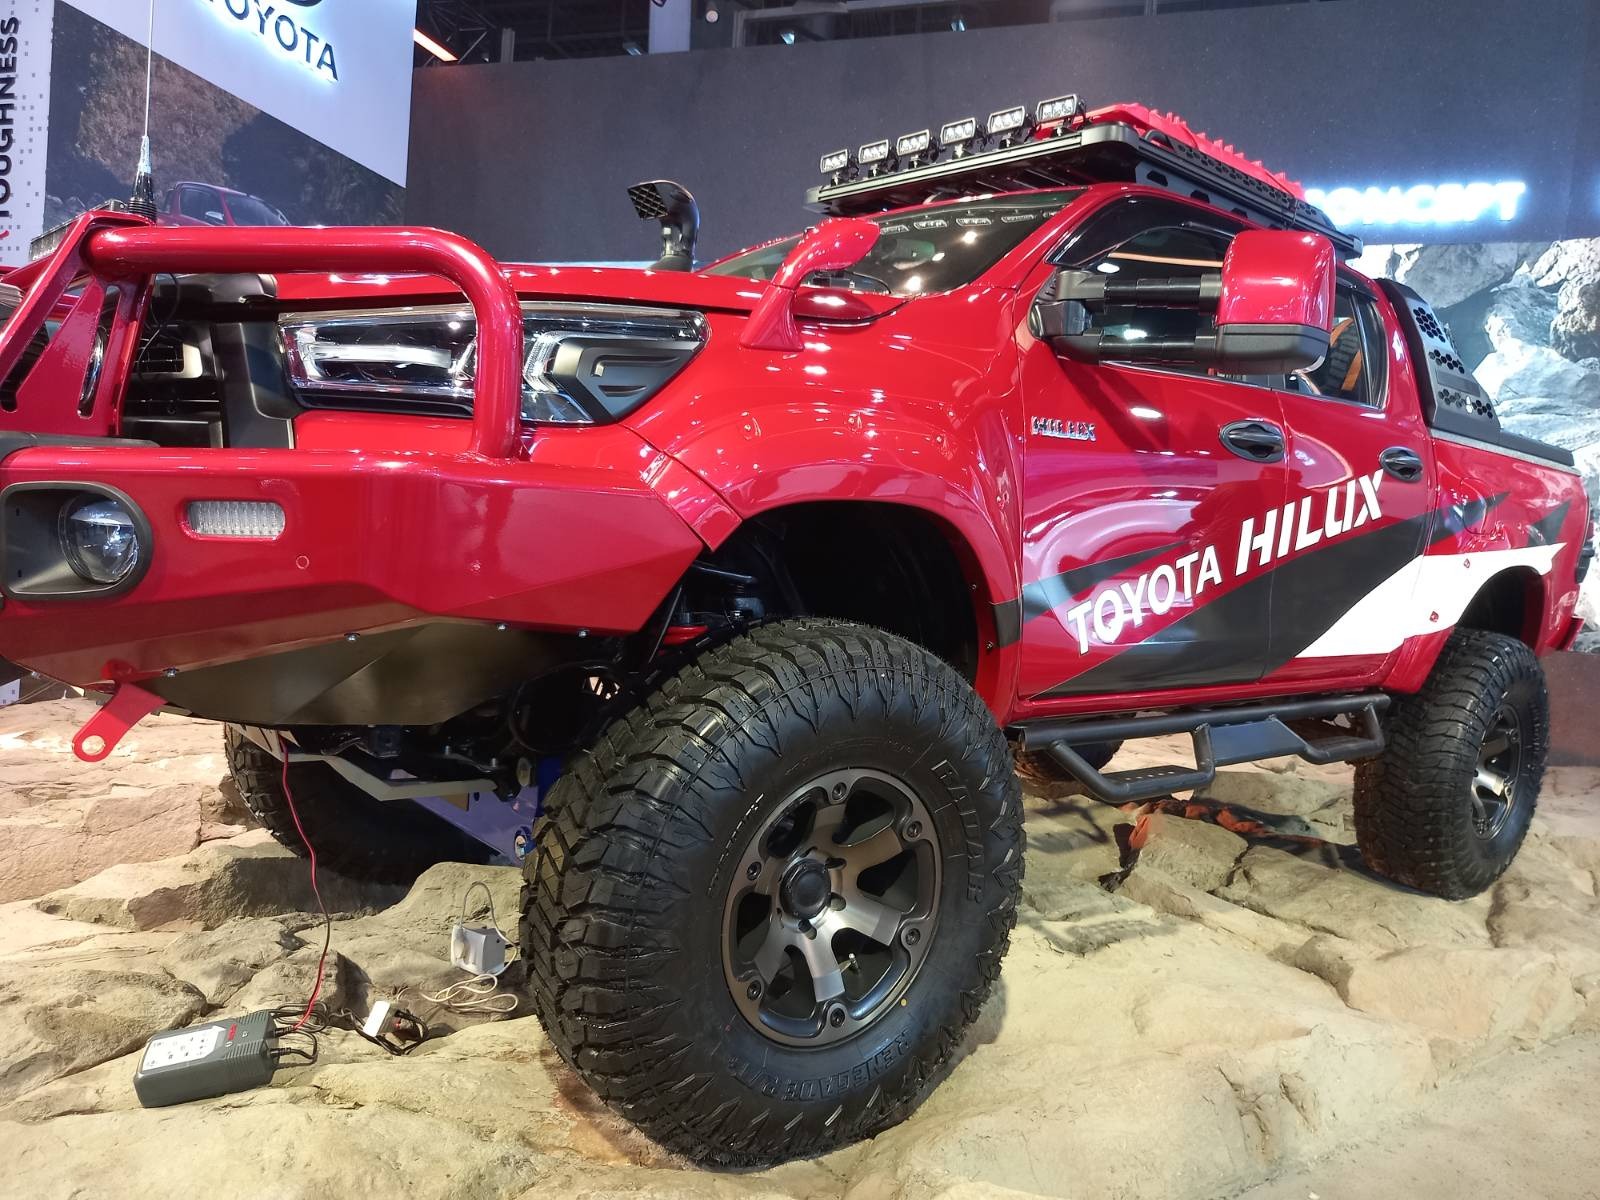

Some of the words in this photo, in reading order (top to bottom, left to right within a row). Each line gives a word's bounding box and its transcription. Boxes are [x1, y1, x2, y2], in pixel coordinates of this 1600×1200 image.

[209, 0, 338, 81] OYOTA
[1031, 416, 1096, 441] HILUX
[1066, 545, 1223, 656] TOYOTA
[1235, 469, 1384, 577] HILUX
